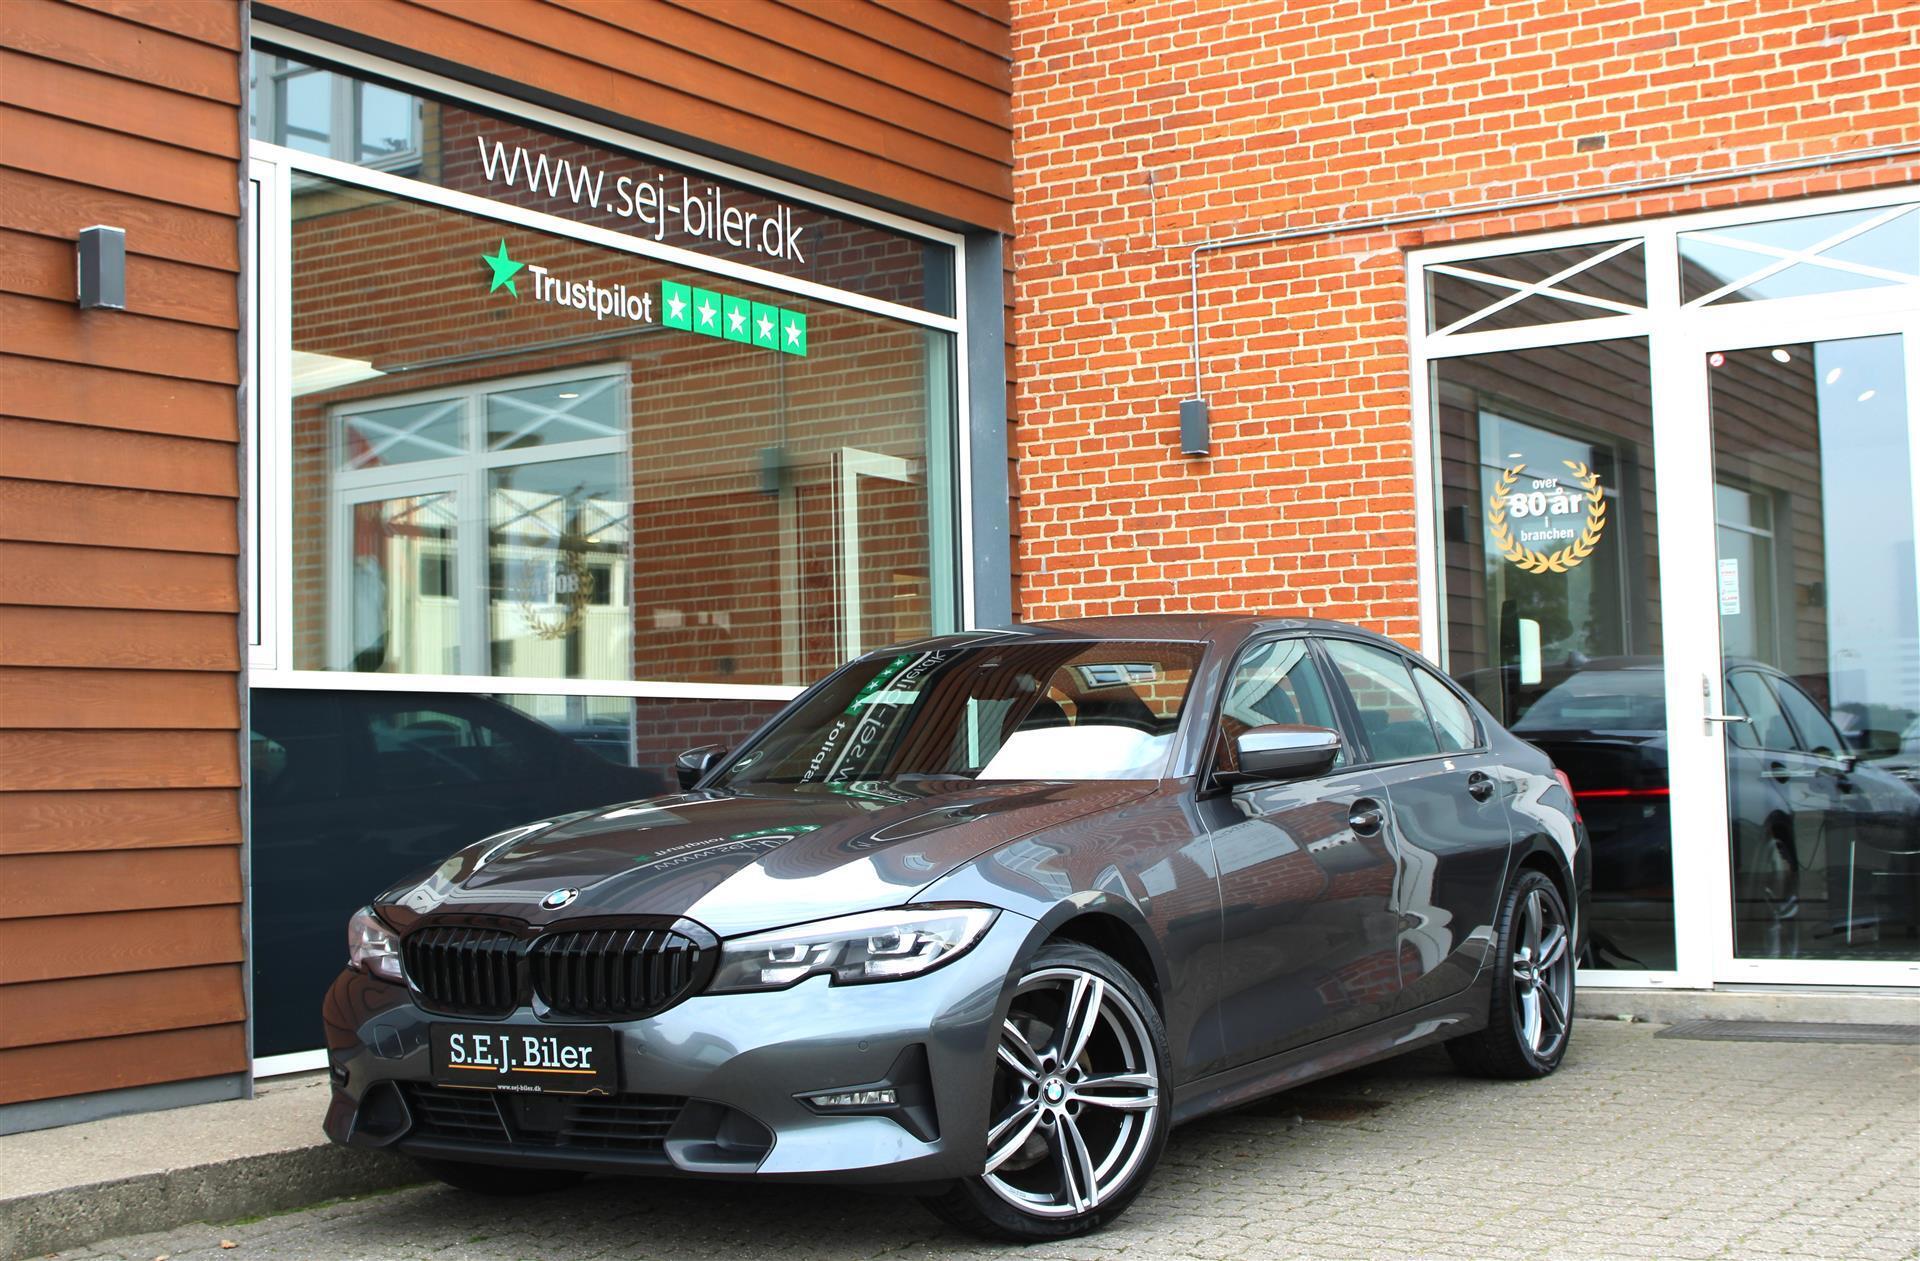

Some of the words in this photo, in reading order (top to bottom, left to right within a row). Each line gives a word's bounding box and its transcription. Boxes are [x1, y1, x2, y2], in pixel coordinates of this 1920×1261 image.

[478, 136, 805, 264] www.sej-biler.dk
[528, 264, 653, 323] Trustpilot
[1532, 477, 1558, 490] over
[1509, 491, 1547, 518] 80
[1551, 487, 1583, 515] år
[1544, 516, 1549, 528] i
[1520, 528, 1574, 542] branchen
[450, 1033, 516, 1074] S.E.J.
[522, 1036, 593, 1069] Biler
[497, 1084, 542, 1092] www.sej-biler.dk
